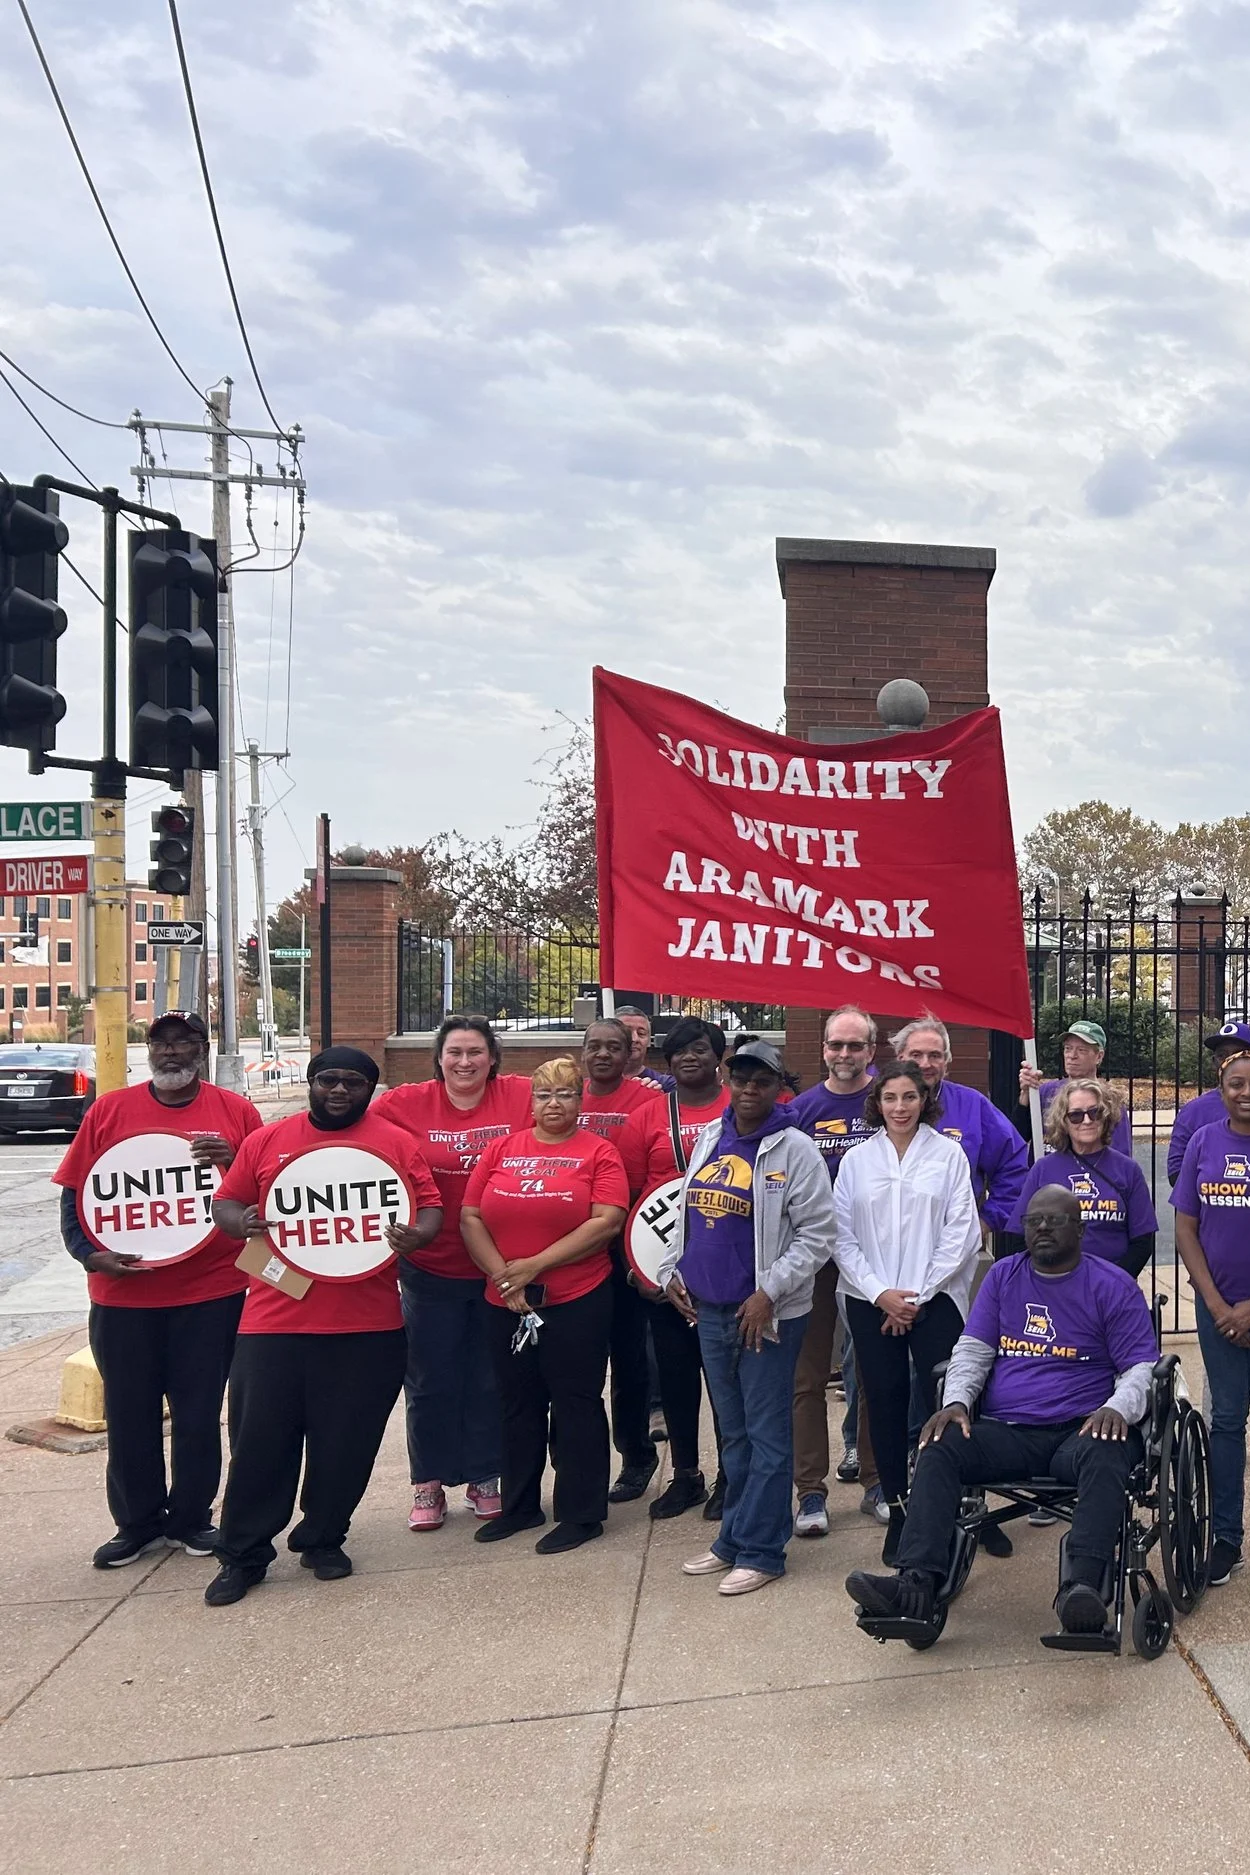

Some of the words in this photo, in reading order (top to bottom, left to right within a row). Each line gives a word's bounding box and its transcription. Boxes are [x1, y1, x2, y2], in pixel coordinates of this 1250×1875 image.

[657, 732, 952, 800] SOLIDARITY
[1, 807, 76, 837] LACE
[732, 811, 861, 868] WITH
[5, 860, 64, 891] DRIVER
[67, 868, 84, 881] WAY
[663, 851, 935, 939] ARAMARK
[151, 928, 171, 938] ONE
[175, 928, 193, 938] WAY
[668, 917, 942, 990] JANITORS
[1219, 1023, 1238, 1036] O
[430, 1133, 467, 1142] UNITE
[447, 1141, 489, 1152] LOCA
[815, 1139, 836, 1149] EIU
[502, 1160, 538, 1168] UNITE
[93, 1164, 214, 1201] UNITE
[520, 1179, 544, 1192] 74
[765, 1182, 785, 1190] SEIU
[1201, 1183, 1247, 1195] SHOW
[274, 1178, 400, 1215] UNITE
[687, 1191, 701, 1204] ONE
[703, 1191, 715, 1206] ST.
[717, 1193, 747, 1215] LOUIS
[1098, 1200, 1118, 1210] ME
[94, 1195, 214, 1234] HERE!
[1080, 1210, 1125, 1221] ENTIAL!
[278, 1211, 398, 1249] HERE!
[1027, 1325, 1047, 1334] SEIU
[1000, 1335, 1047, 1353] SHOW
[1052, 1345, 1077, 1358] ME
